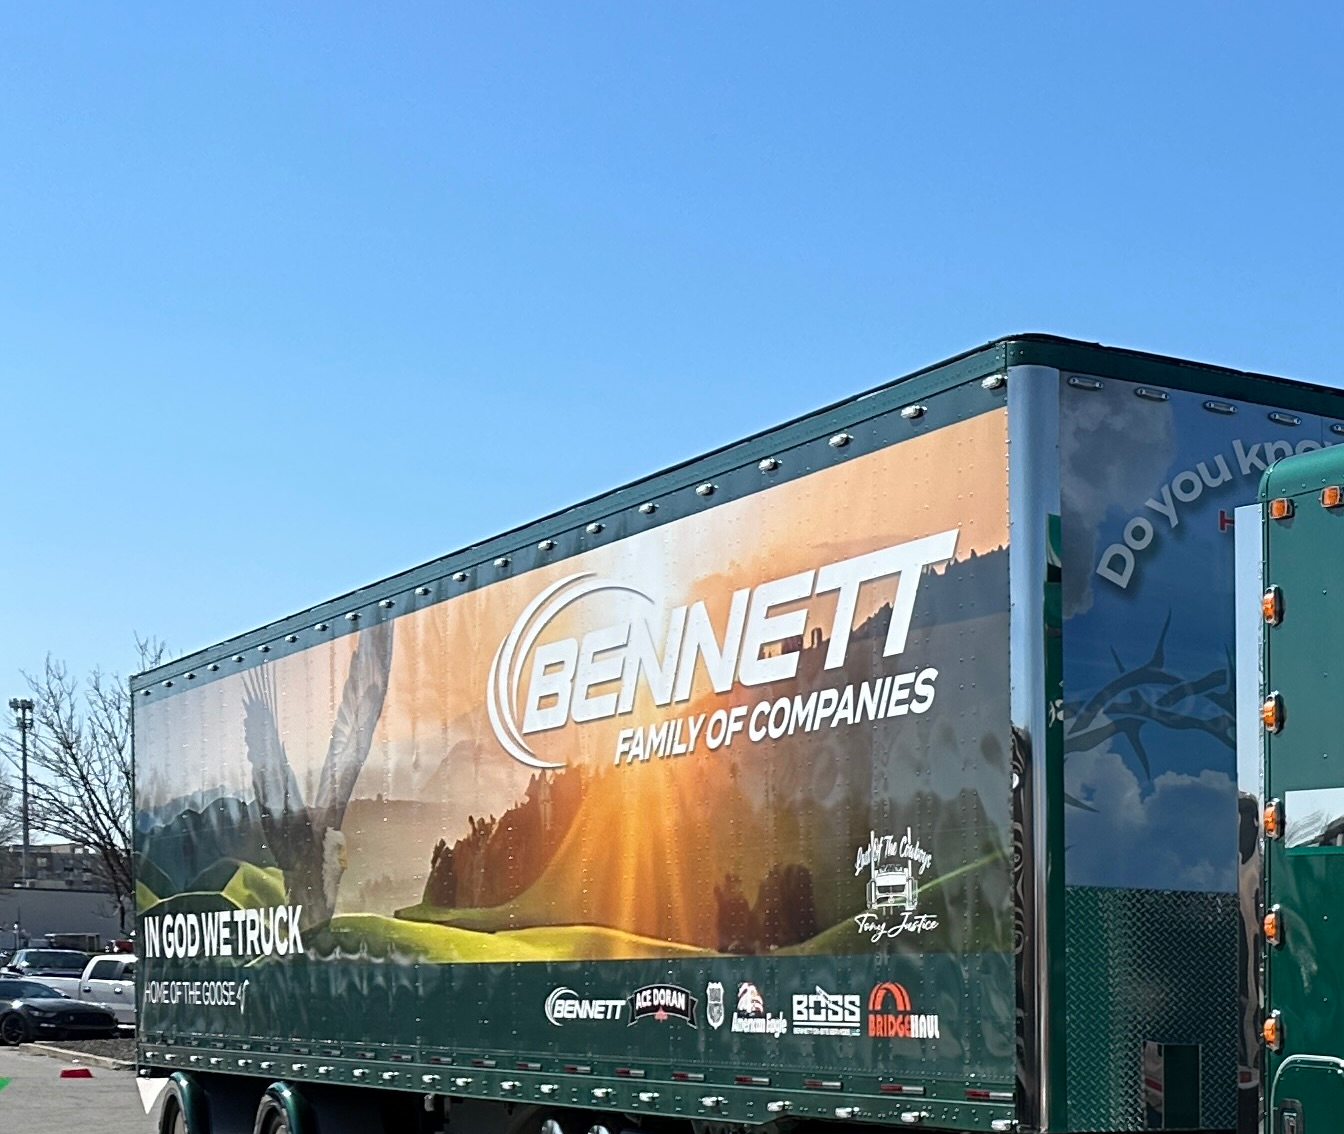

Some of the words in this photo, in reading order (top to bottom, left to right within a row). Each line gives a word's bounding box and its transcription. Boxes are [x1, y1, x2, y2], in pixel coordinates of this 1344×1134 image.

[1096, 517, 1154, 589] Do
[1144, 454, 1233, 528] you
[1232, 439, 1338, 476] kno
[523, 529, 960, 734] BENNETT
[613, 712, 707, 765] FAMILY
[706, 704, 749, 751] OF
[748, 667, 939, 743] COMPANIES
[144, 916, 160, 957] IN
[163, 913, 200, 958] GOD
[201, 911, 232, 956] WE
[233, 905, 304, 956] TRUCK
[854, 913, 887, 942] Tony
[887, 912, 939, 938] Justice
[145, 981, 169, 1004] HOME
[170, 981, 182, 1004] OF
[182, 981, 201, 1004] THE
[202, 981, 236, 1005] GOOSE
[635, 990, 652, 1010] ACE
[652, 989, 686, 1011] DORAN
[793, 993, 861, 1022] BOSS
[553, 999, 627, 1020] BENNETT
